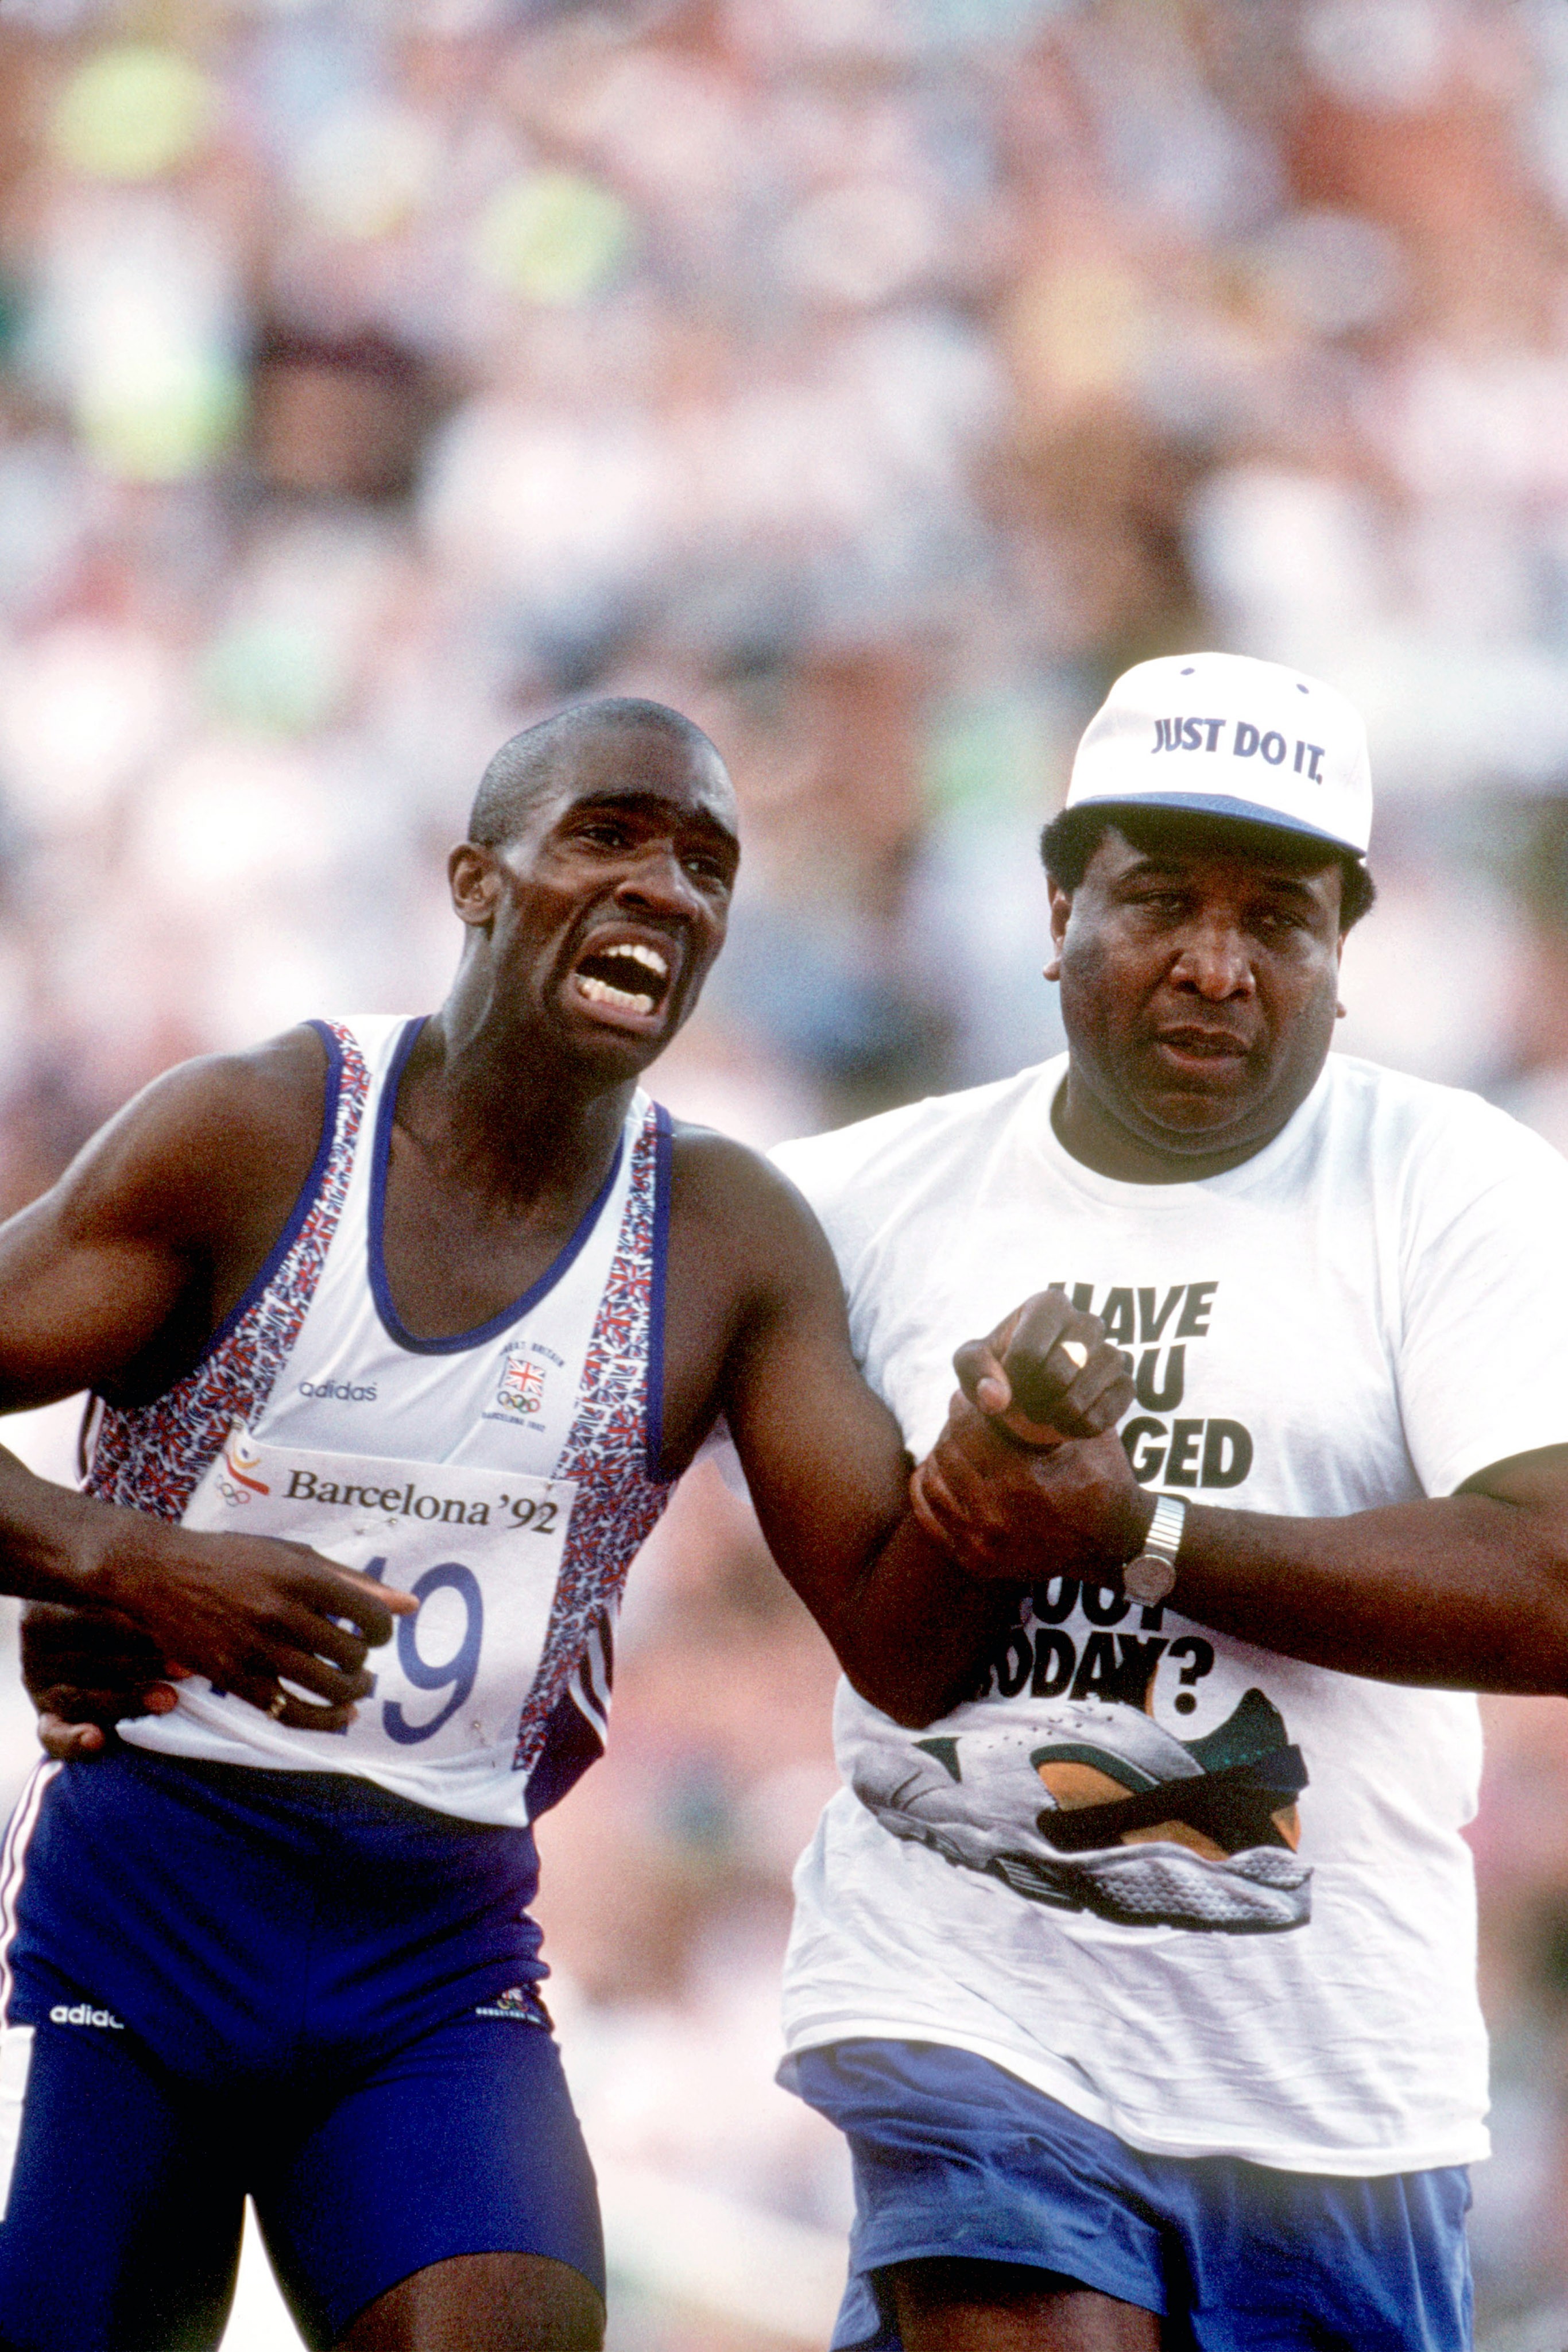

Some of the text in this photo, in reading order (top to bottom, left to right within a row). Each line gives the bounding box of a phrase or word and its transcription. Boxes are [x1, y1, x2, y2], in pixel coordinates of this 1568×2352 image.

[1151, 717, 1325, 786] JUST DO IT.
[299, 1379, 377, 1402] adidas
[1120, 1416, 1253, 1488] GED
[284, 1469, 559, 1534] Barcelona '92
[976, 1627, 1215, 1715] ODAY?
[49, 2003, 125, 2029] adid
